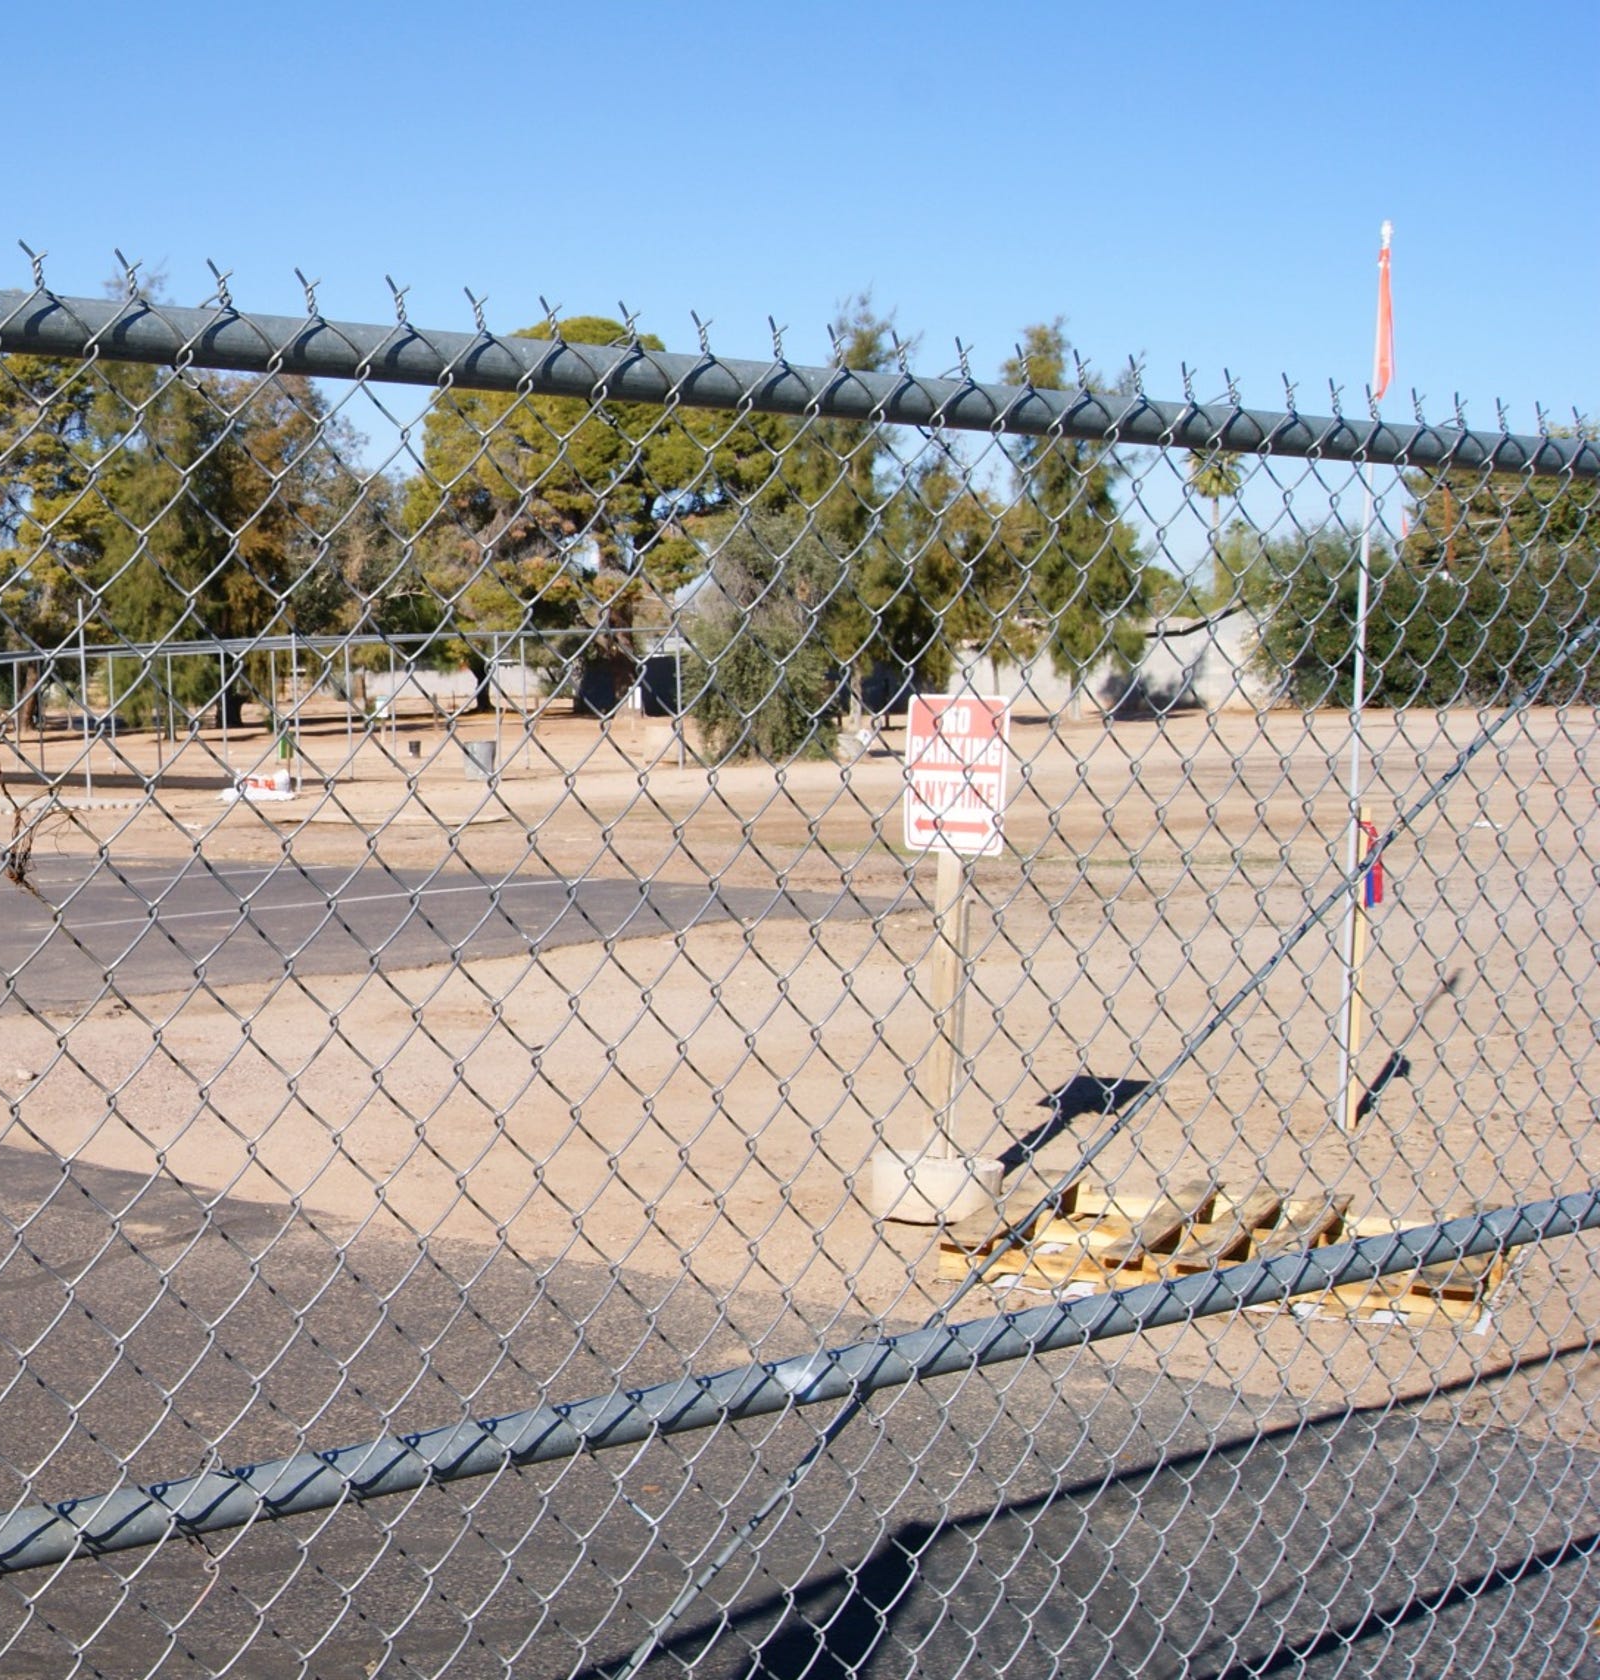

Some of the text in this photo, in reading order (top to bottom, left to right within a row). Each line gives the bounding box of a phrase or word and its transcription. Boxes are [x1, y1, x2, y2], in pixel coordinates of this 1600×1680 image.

[942, 706, 971, 734] NO
[911, 735, 1001, 766] PARKING
[912, 780, 997, 810] ANYTIME
